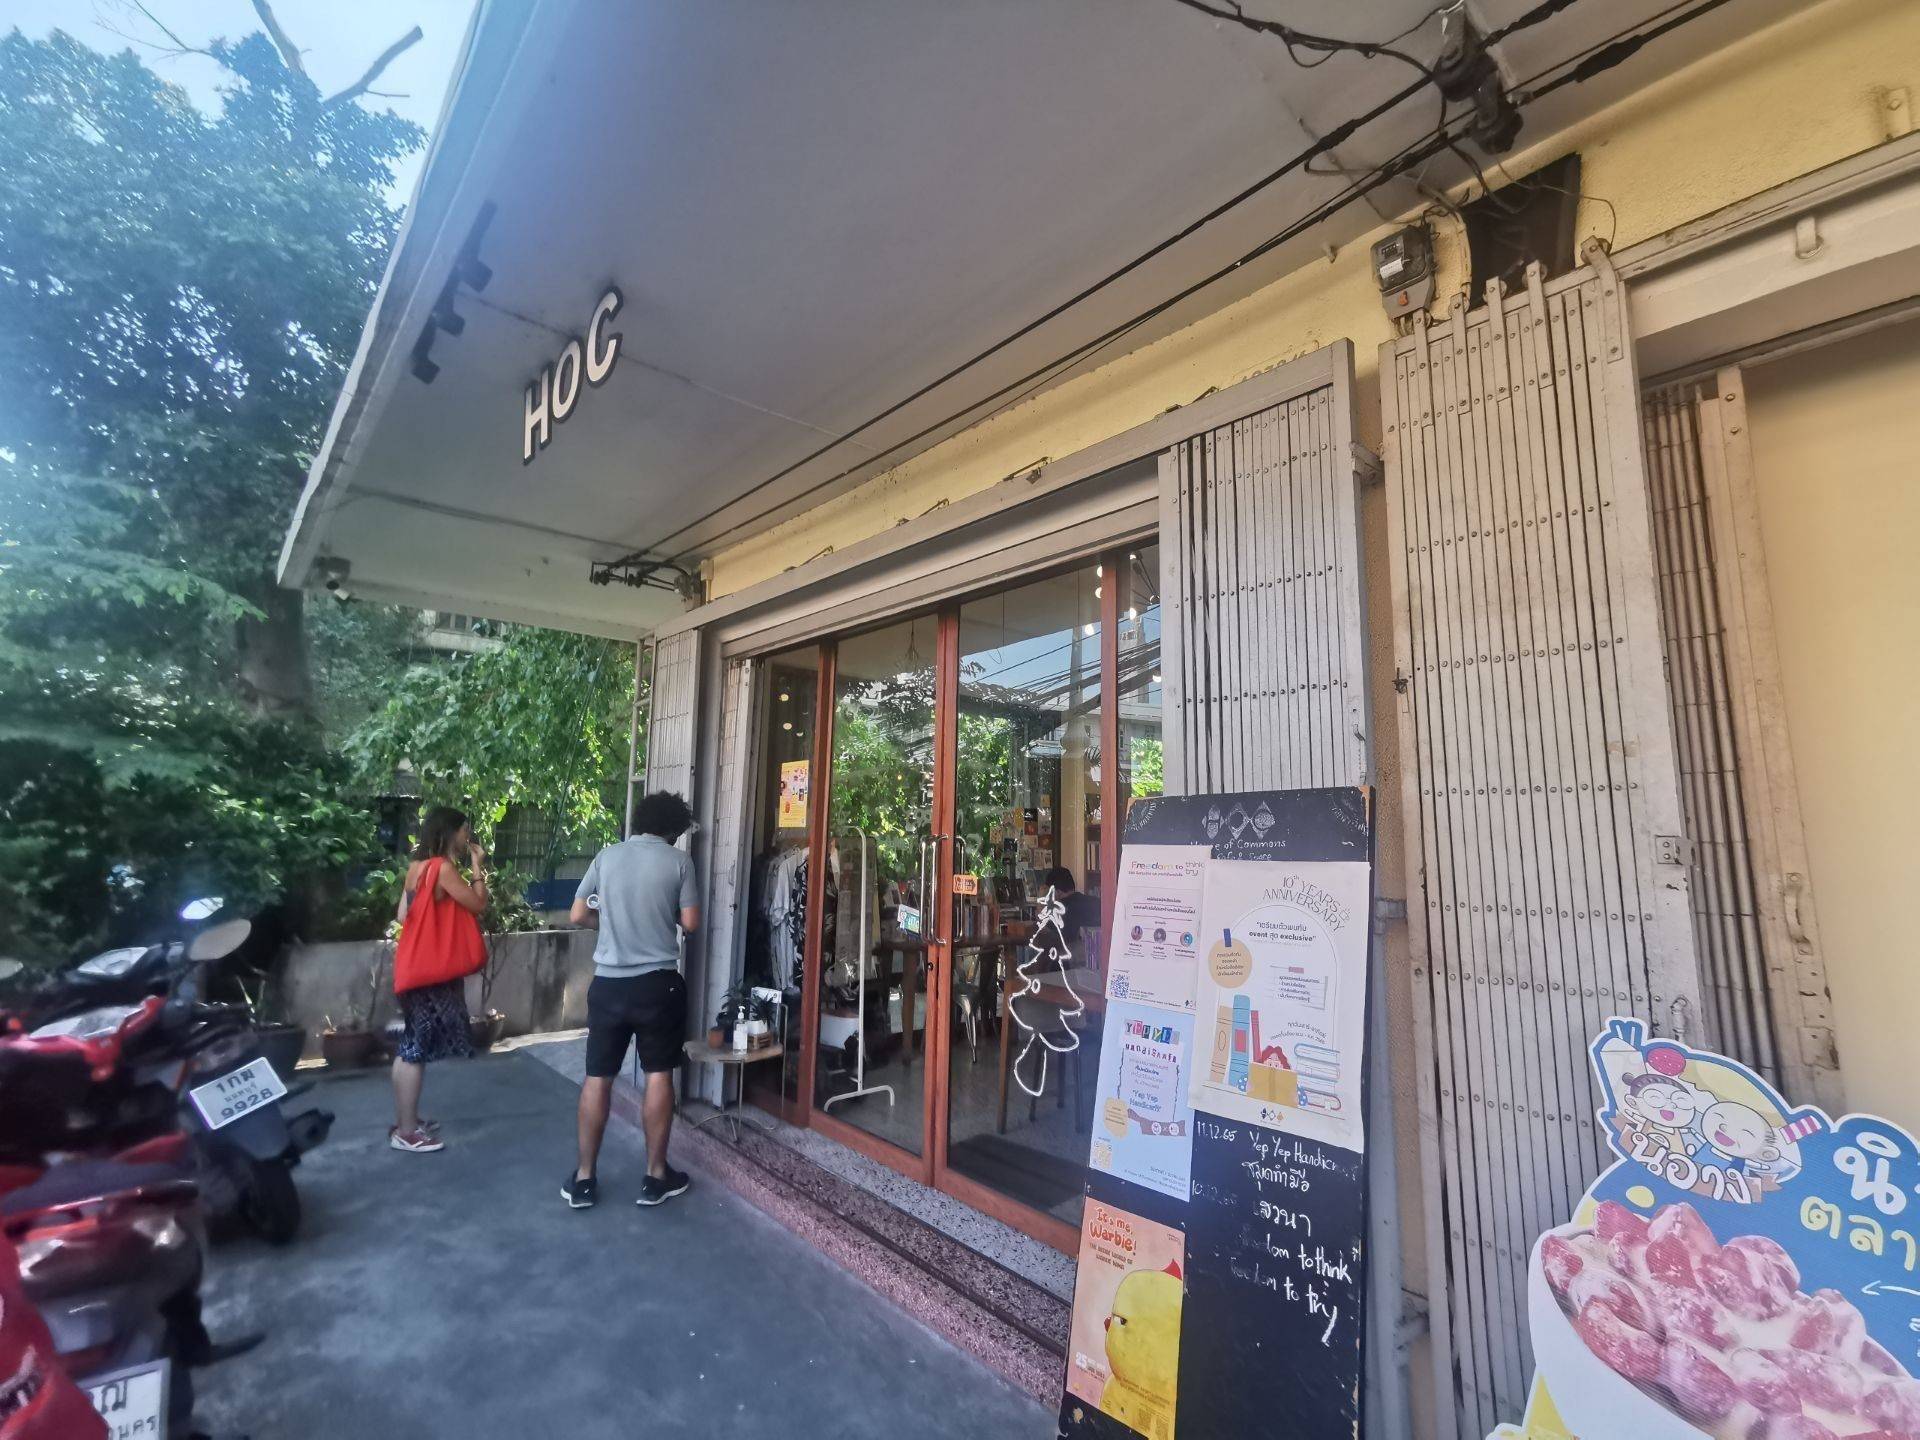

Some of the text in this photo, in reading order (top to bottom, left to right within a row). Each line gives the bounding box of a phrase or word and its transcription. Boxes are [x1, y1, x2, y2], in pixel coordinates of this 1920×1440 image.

[523, 286, 622, 465] HOC
[1237, 839, 1286, 849] Commons
[1131, 860, 1174, 871] Freedom
[1262, 888, 1345, 932] ANNIVERSARY
[1301, 880, 1341, 913] YEARS
[1249, 931, 1268, 939] event
[220, 1087, 273, 1120] 9928
[1250, 1130, 1269, 1161] Yep
[1272, 1135, 1291, 1164] Yep
[1258, 1200, 1312, 1238] สวนา
[1089, 1220, 1137, 1256] Warbie!
[1298, 1244, 1313, 1270] to
[1315, 1246, 1353, 1284] think
[1284, 1276, 1300, 1301] to
[1305, 1283, 1338, 1347] try
